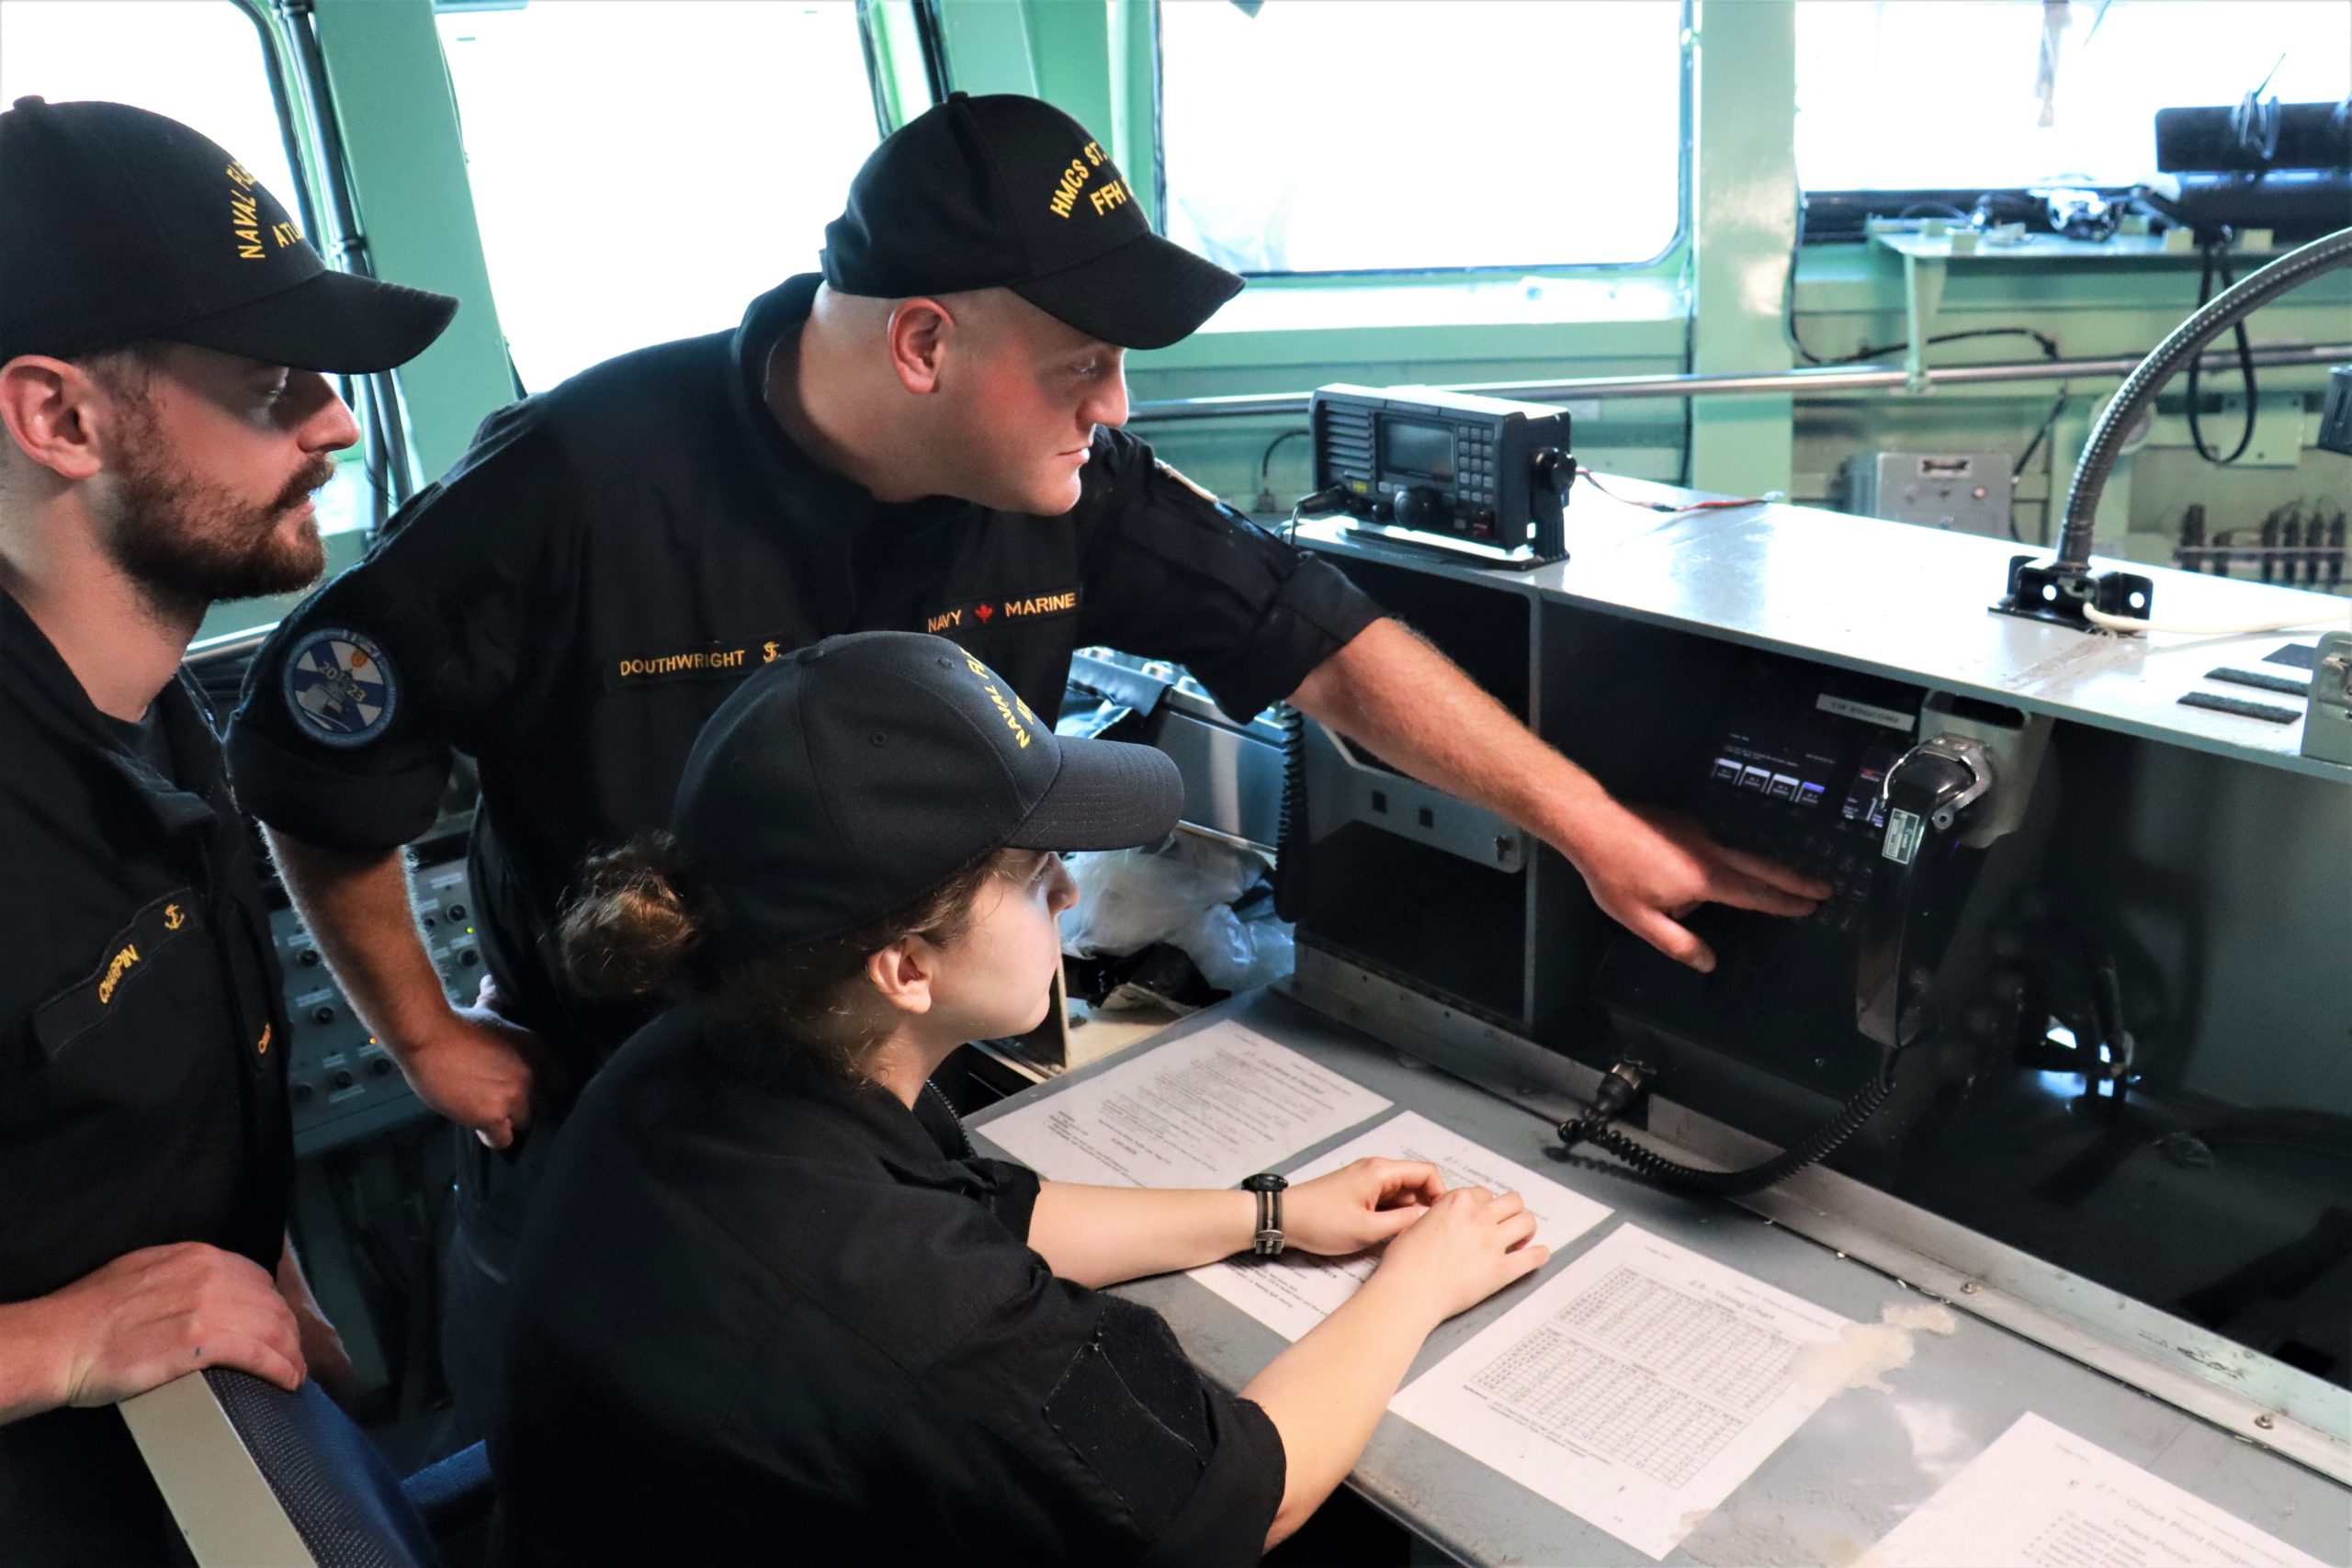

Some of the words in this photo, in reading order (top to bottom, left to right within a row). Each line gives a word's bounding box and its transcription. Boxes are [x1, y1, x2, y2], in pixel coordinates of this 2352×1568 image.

[1050, 159, 1090, 219] HMCS
[1090, 180, 1126, 216] FFH
[232, 190, 266, 259] NAVAL
[928, 610, 963, 633] NAVY
[1005, 592, 1076, 616] MARINE
[619, 649, 745, 677] DOUTHWRIGHT
[346, 683, 366, 702] 23
[2111, 1517, 2153, 1541] Check
[2124, 1498, 2168, 1523] Check
[2168, 1520, 2207, 1543] Point
